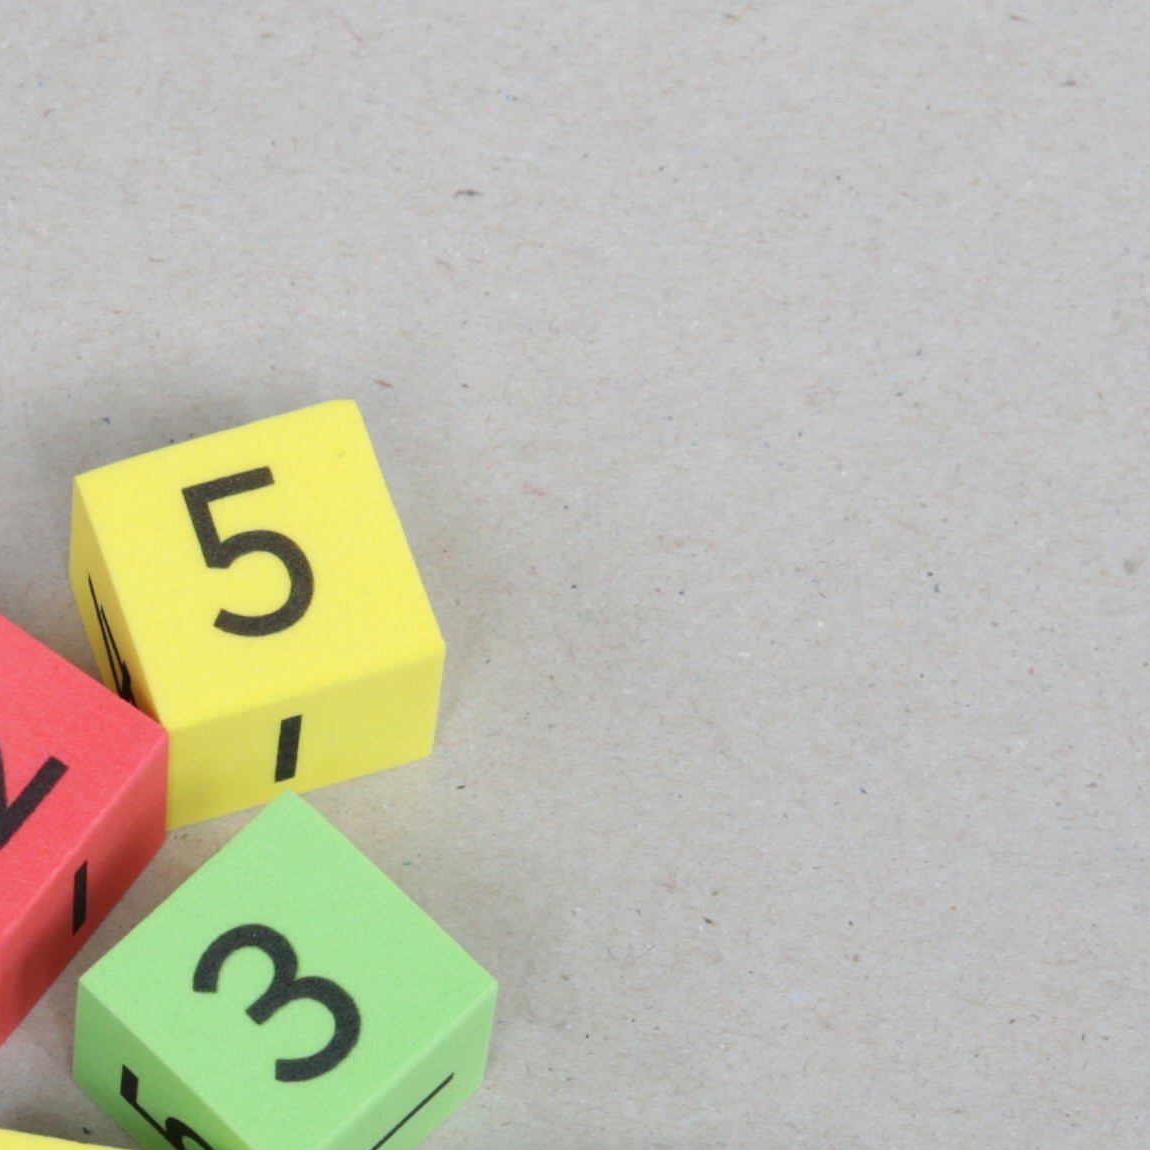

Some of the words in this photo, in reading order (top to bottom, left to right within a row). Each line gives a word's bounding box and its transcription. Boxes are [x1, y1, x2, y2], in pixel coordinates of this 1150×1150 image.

[182, 467, 314, 636] 5
[274, 714, 303, 783] 1
[70, 861, 90, 938] 1
[192, 923, 362, 1083] 3
